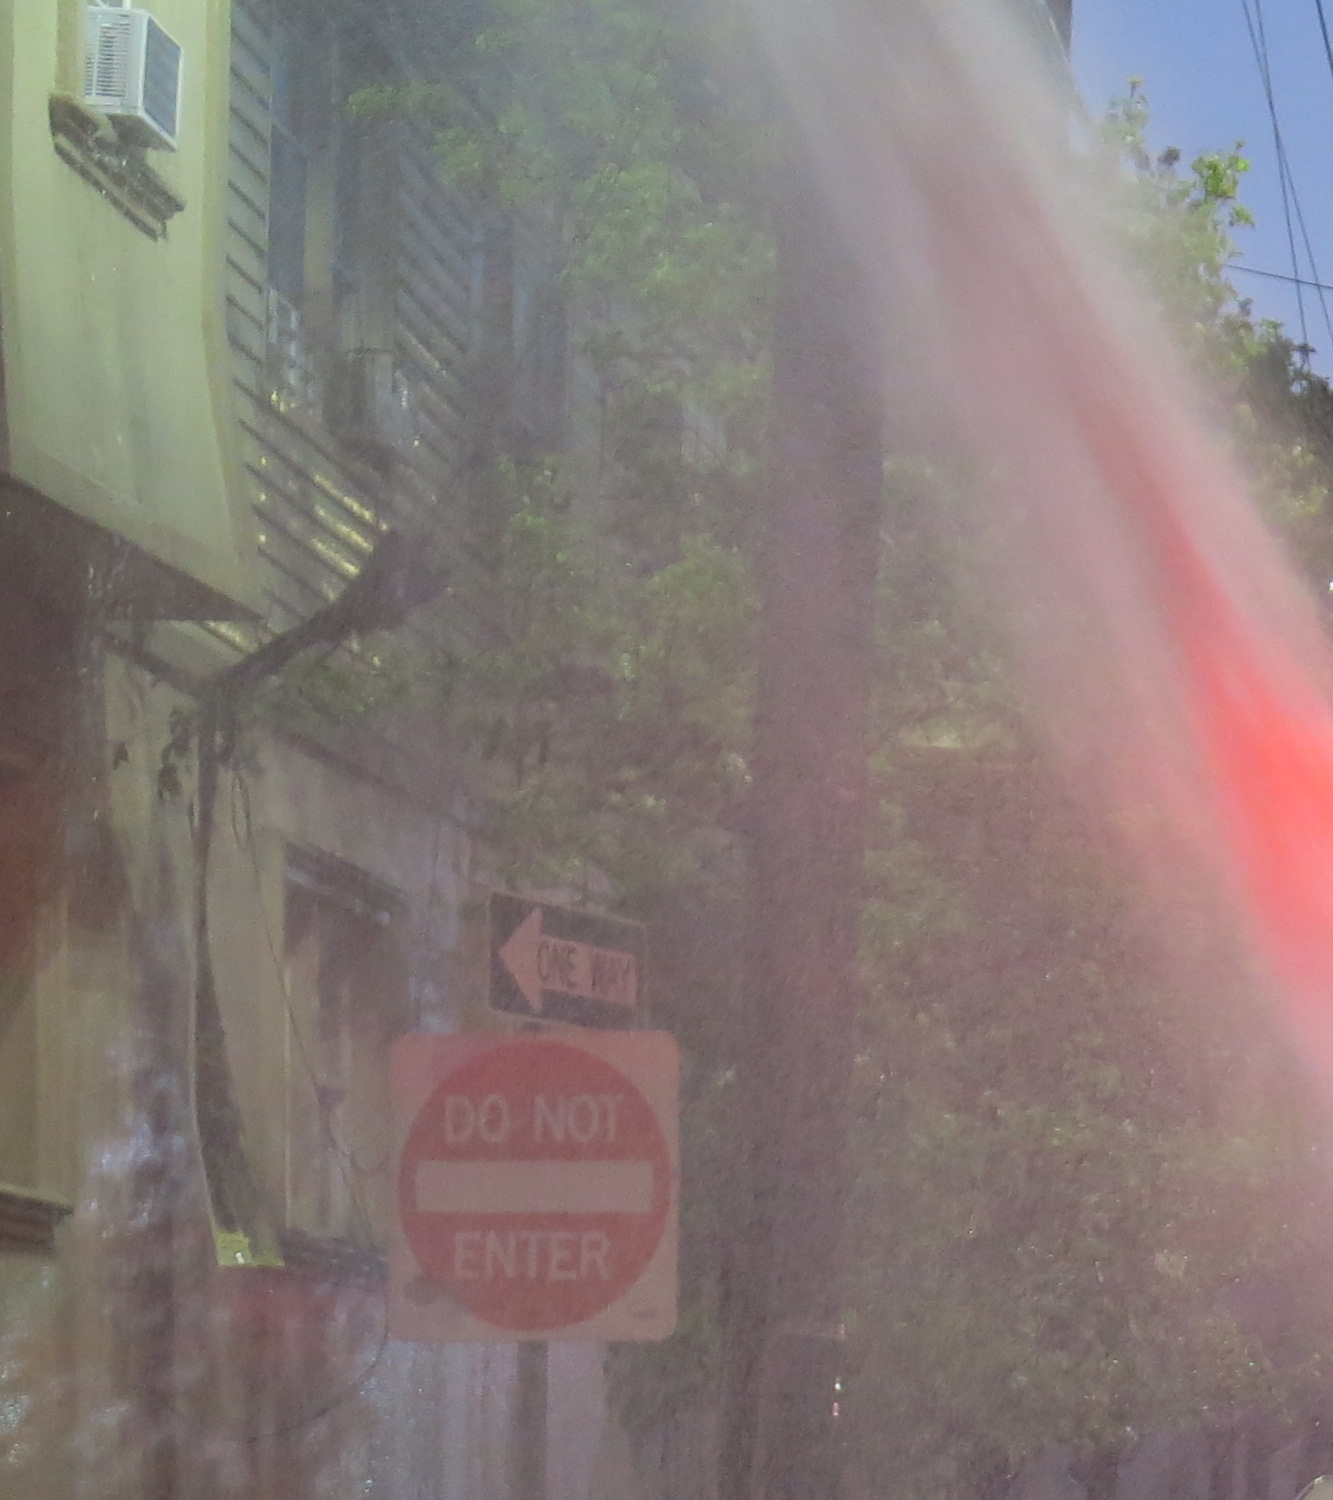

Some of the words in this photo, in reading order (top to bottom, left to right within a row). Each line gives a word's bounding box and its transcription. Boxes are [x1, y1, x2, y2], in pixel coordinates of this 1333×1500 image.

[537, 942, 577, 989] ONE
[590, 952, 633, 997] WAY
[443, 1095, 510, 1143] DO
[534, 1094, 625, 1142] NOT
[454, 1231, 611, 1281] ENTER
